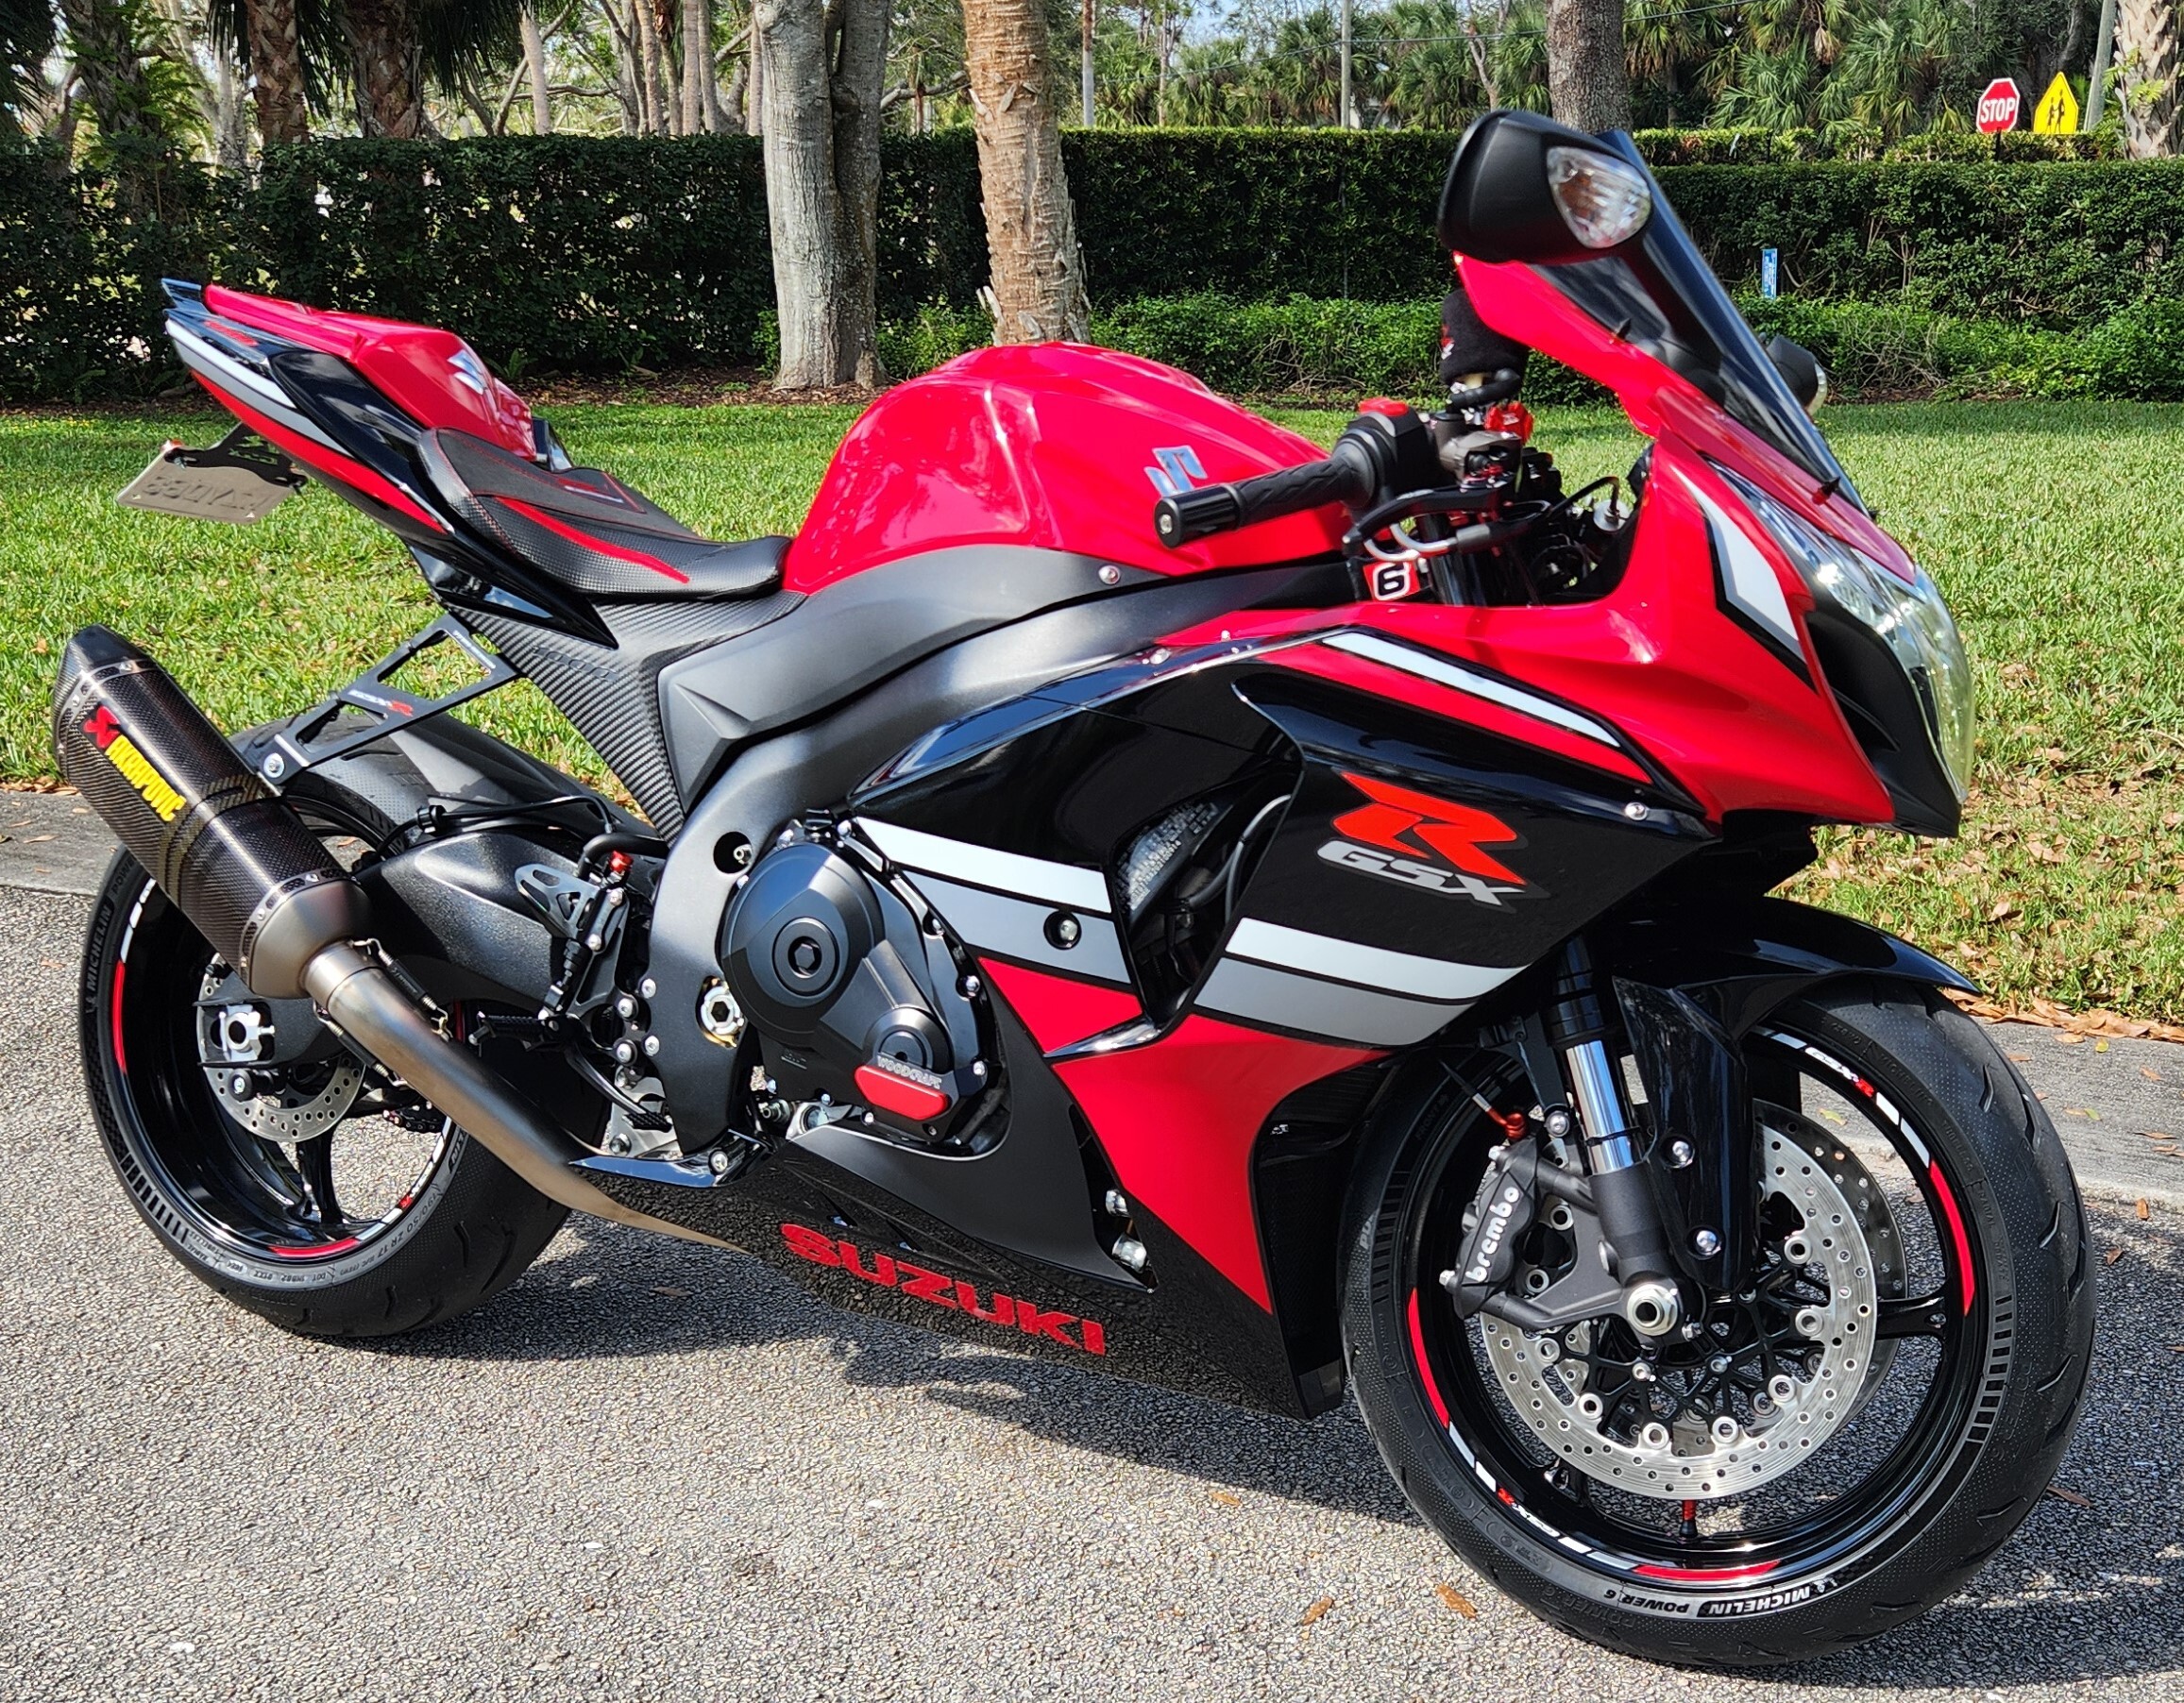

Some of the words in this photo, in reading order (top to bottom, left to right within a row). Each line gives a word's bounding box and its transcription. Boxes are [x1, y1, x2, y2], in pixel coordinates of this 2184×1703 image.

[1980, 97, 2016, 123] STOP
[1375, 563, 1408, 599] 6
[1333, 771, 1527, 885] R
[1317, 840, 1526, 906] GSX
[87, 903, 112, 988] MICHELIN
[110, 856, 136, 896] POWE
[877, 1054, 941, 1089] WOODCRAFT
[407, 1192, 438, 1233] 190/50
[378, 1245, 389, 1256] 17
[391, 1231, 404, 1245] ZR
[1465, 1187, 1519, 1282] brembo
[312, 1272, 327, 1282] DOT
[781, 1223, 1106, 1356] SUZUKI
[1603, 1589, 1617, 1599] 6
[1621, 1592, 1690, 1613] POWER
[1708, 1586, 1811, 1615] MICHELIN
